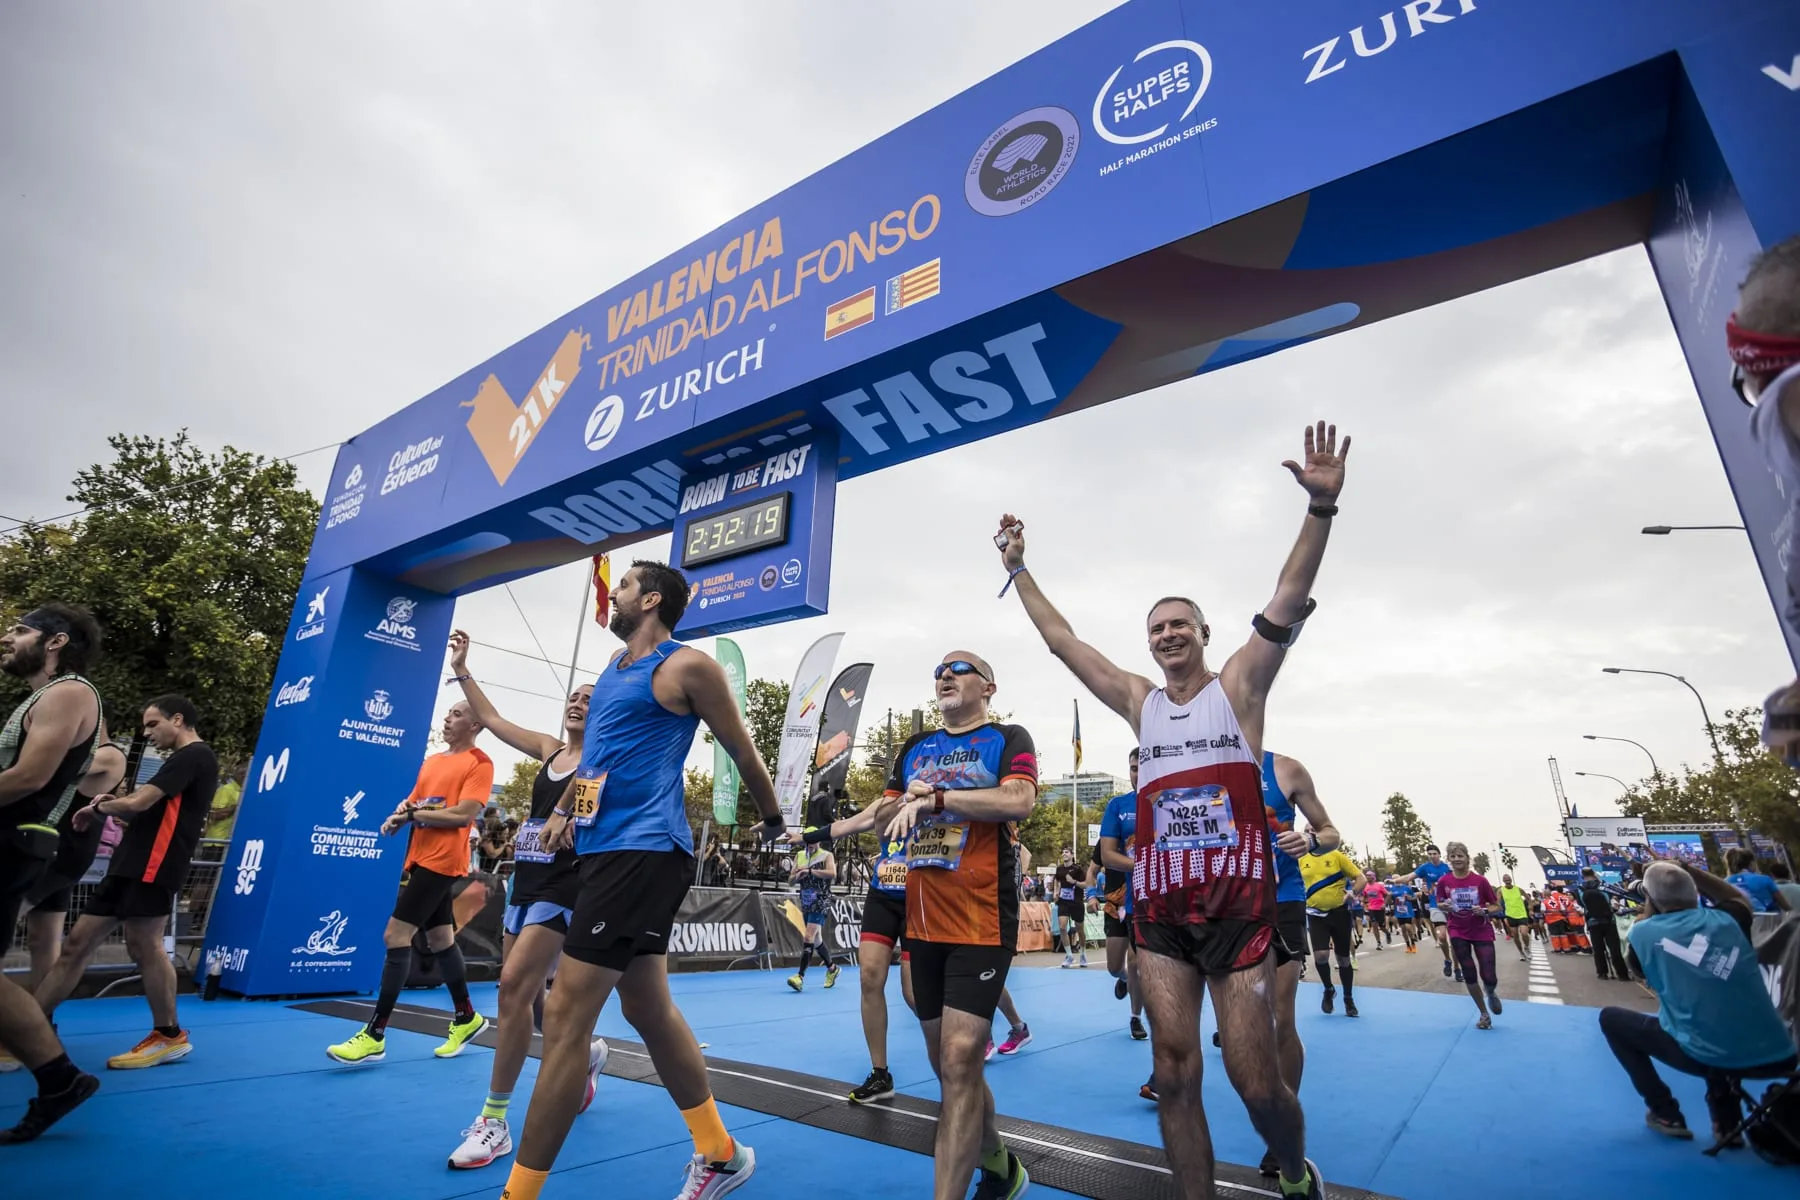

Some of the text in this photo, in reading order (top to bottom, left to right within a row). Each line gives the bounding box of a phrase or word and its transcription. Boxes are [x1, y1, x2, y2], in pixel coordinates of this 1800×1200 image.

[1113, 61, 1190, 107] SUPER
[1114, 77, 1191, 123] HALFS
[1100, 117, 1218, 176] HALF MARATHON SERIES
[996, 166, 1047, 196] ATHLETICS
[1003, 163, 1038, 184] WORLD
[1020, 135, 1076, 207] ROAD RACE 2022
[607, 215, 784, 343] VALENCIA
[597, 193, 942, 391] TRINIDAD ALFONSO
[635, 337, 765, 422] ZURICH
[821, 322, 1057, 456] FAST
[508, 363, 566, 459] 21K
[430, 435, 444, 452] del
[380, 454, 439, 496] Esfuerzo
[679, 473, 730, 515] BORN
[761, 443, 812, 487] FAST
[528, 459, 689, 545] BORN
[325, 505, 361, 530] ALFONSO
[689, 505, 780, 556] 2:32:19
[703, 572, 735, 587] VALENCIA
[726, 577, 755, 591] ALFONSO
[708, 594, 731, 606] ZURICH
[376, 619, 417, 640] AIMS
[338, 729, 401, 748] DE VALÈNCIA
[341, 718, 405, 737] AJUNTAMENT
[936, 747, 979, 767] rehab
[576, 784, 587, 797] 57
[1169, 804, 1209, 820] 14242
[313, 824, 379, 837] Comunitat Valenciana
[1164, 817, 1219, 838] JOSÉ M
[310, 832, 378, 849] COMUNITAT
[312, 844, 383, 860] DE L'ESPORT
[668, 922, 757, 953] RUNNING
